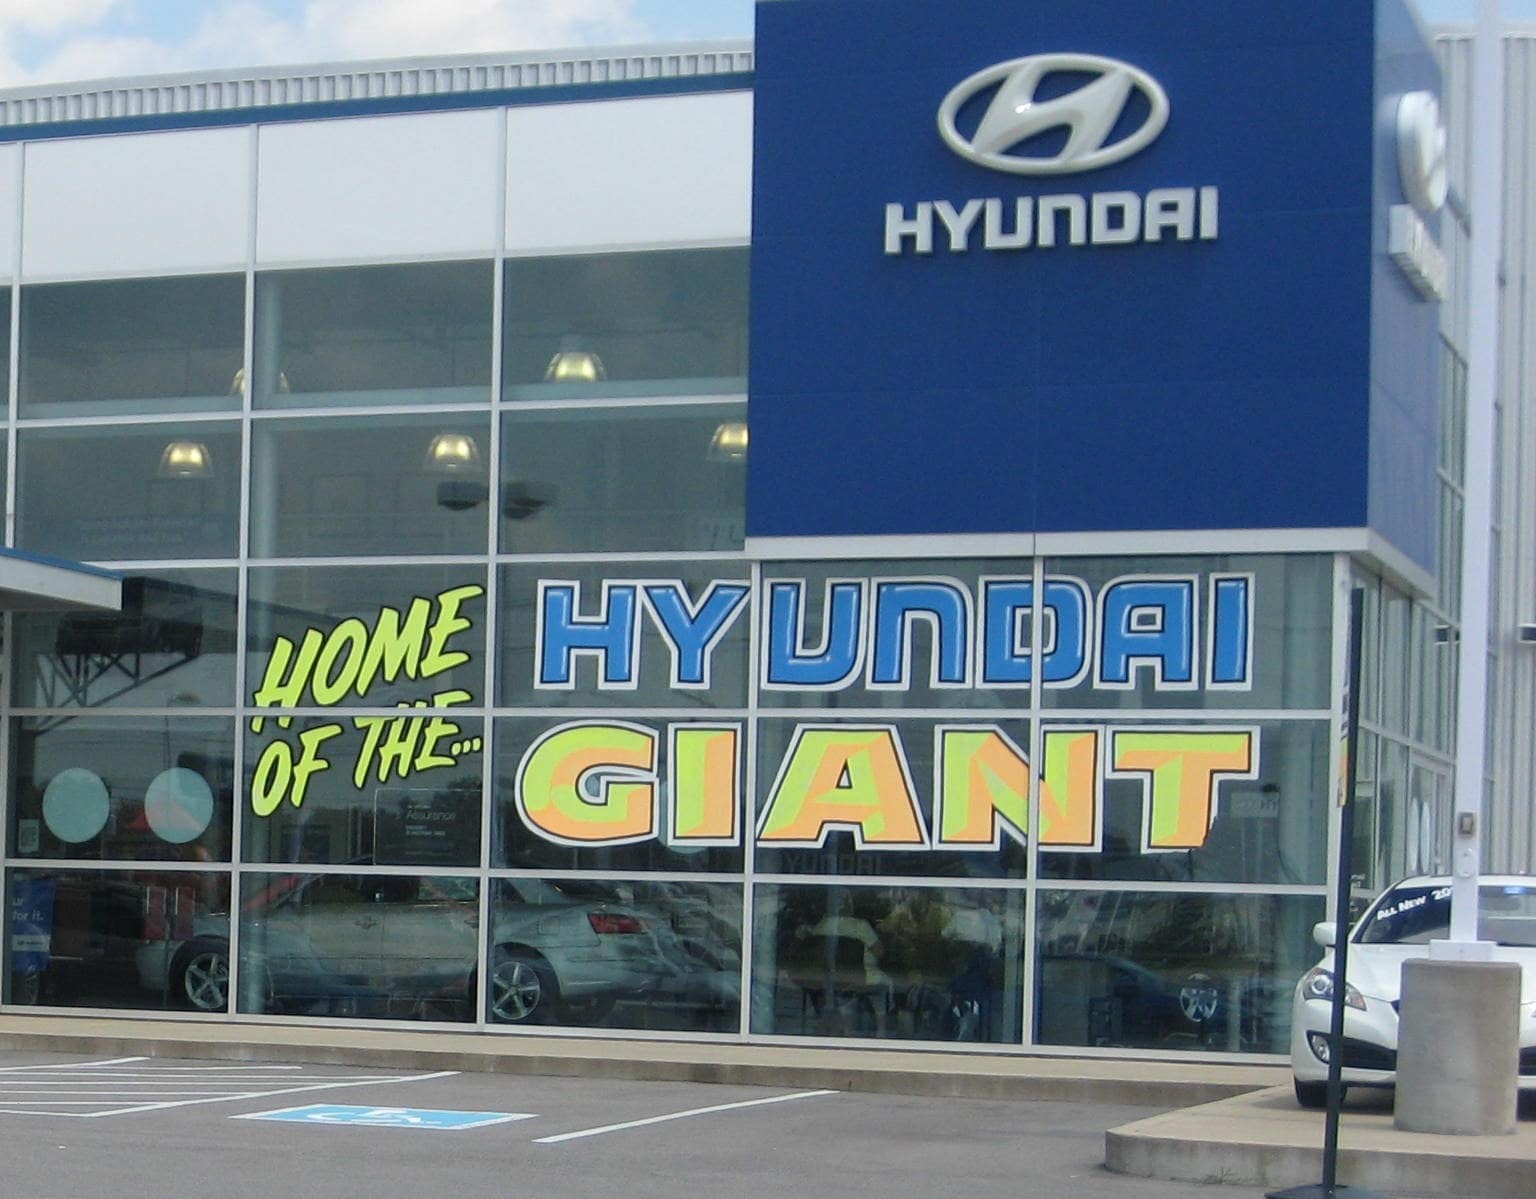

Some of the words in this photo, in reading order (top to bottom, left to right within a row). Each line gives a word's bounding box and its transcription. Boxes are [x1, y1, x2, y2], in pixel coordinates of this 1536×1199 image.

[884, 185, 1220, 255] HYUNDAI
[250, 584, 484, 734] HOME
[533, 575, 1255, 691] HYUNDAI
[250, 723, 343, 817] OF
[352, 690, 482, 790] THE...
[514, 719, 1262, 853] GIANT
